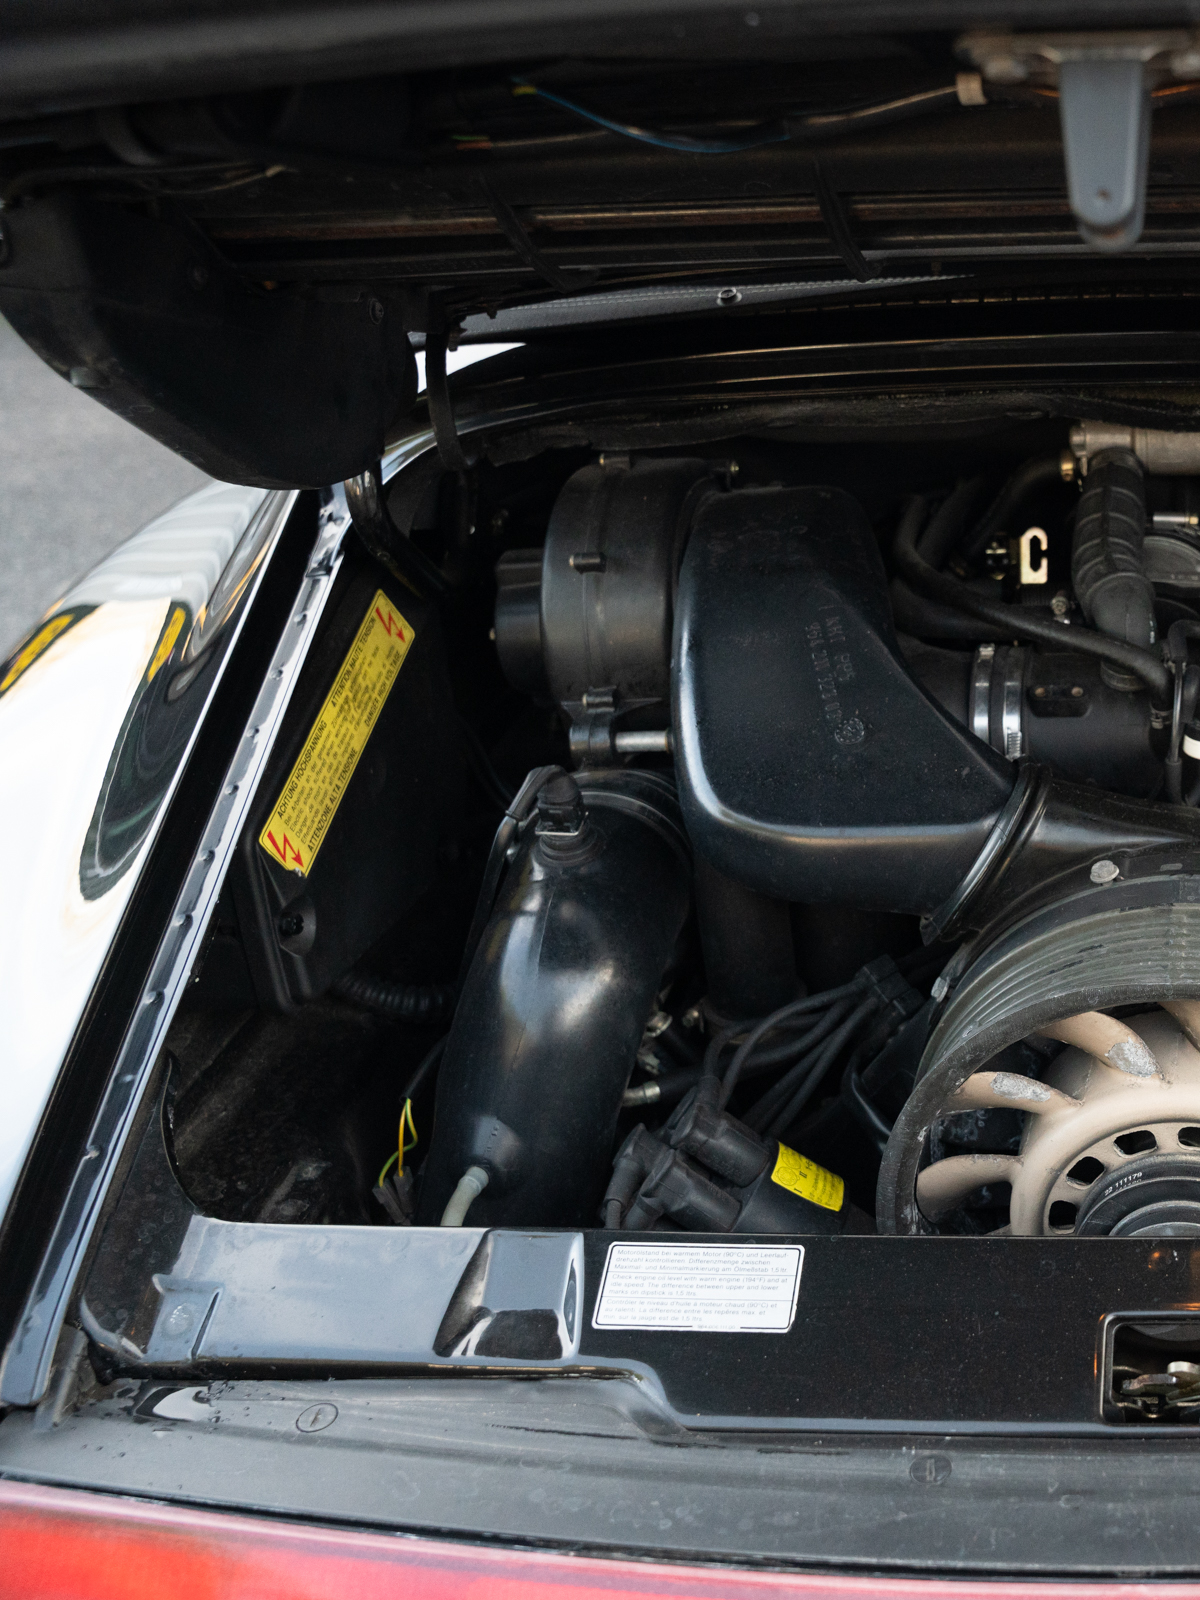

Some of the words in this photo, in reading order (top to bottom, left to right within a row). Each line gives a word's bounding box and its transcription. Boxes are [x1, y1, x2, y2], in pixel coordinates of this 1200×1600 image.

[329, 666, 352, 708] ATTENTION
[347, 643, 363, 670] HAUTE
[359, 614, 377, 647] TENSION
[363, 696, 380, 728] DANGER
[376, 679, 388, 699] HIGH
[384, 648, 402, 682] VOLTAGE
[275, 779, 299, 820] ACHTUNG
[293, 718, 327, 782] HOCHSPANNUNG
[306, 802, 332, 852] ATTENZIONE
[328, 782, 341, 805] ALTA
[337, 746, 358, 784] TENSIONE
[721, 1251, 745, 1259] (90°C)
[687, 1257, 739, 1266] Differenzmenge
[658, 1264, 720, 1273] Minimalmarkierung
[633, 1274, 656, 1282] engine
[717, 1275, 741, 1283] engine
[741, 1276, 766, 1284] (194°F)
[724, 1283, 745, 1291] upper
[723, 1300, 745, 1308] chaud
[745, 1301, 769, 1309] (90°C)
